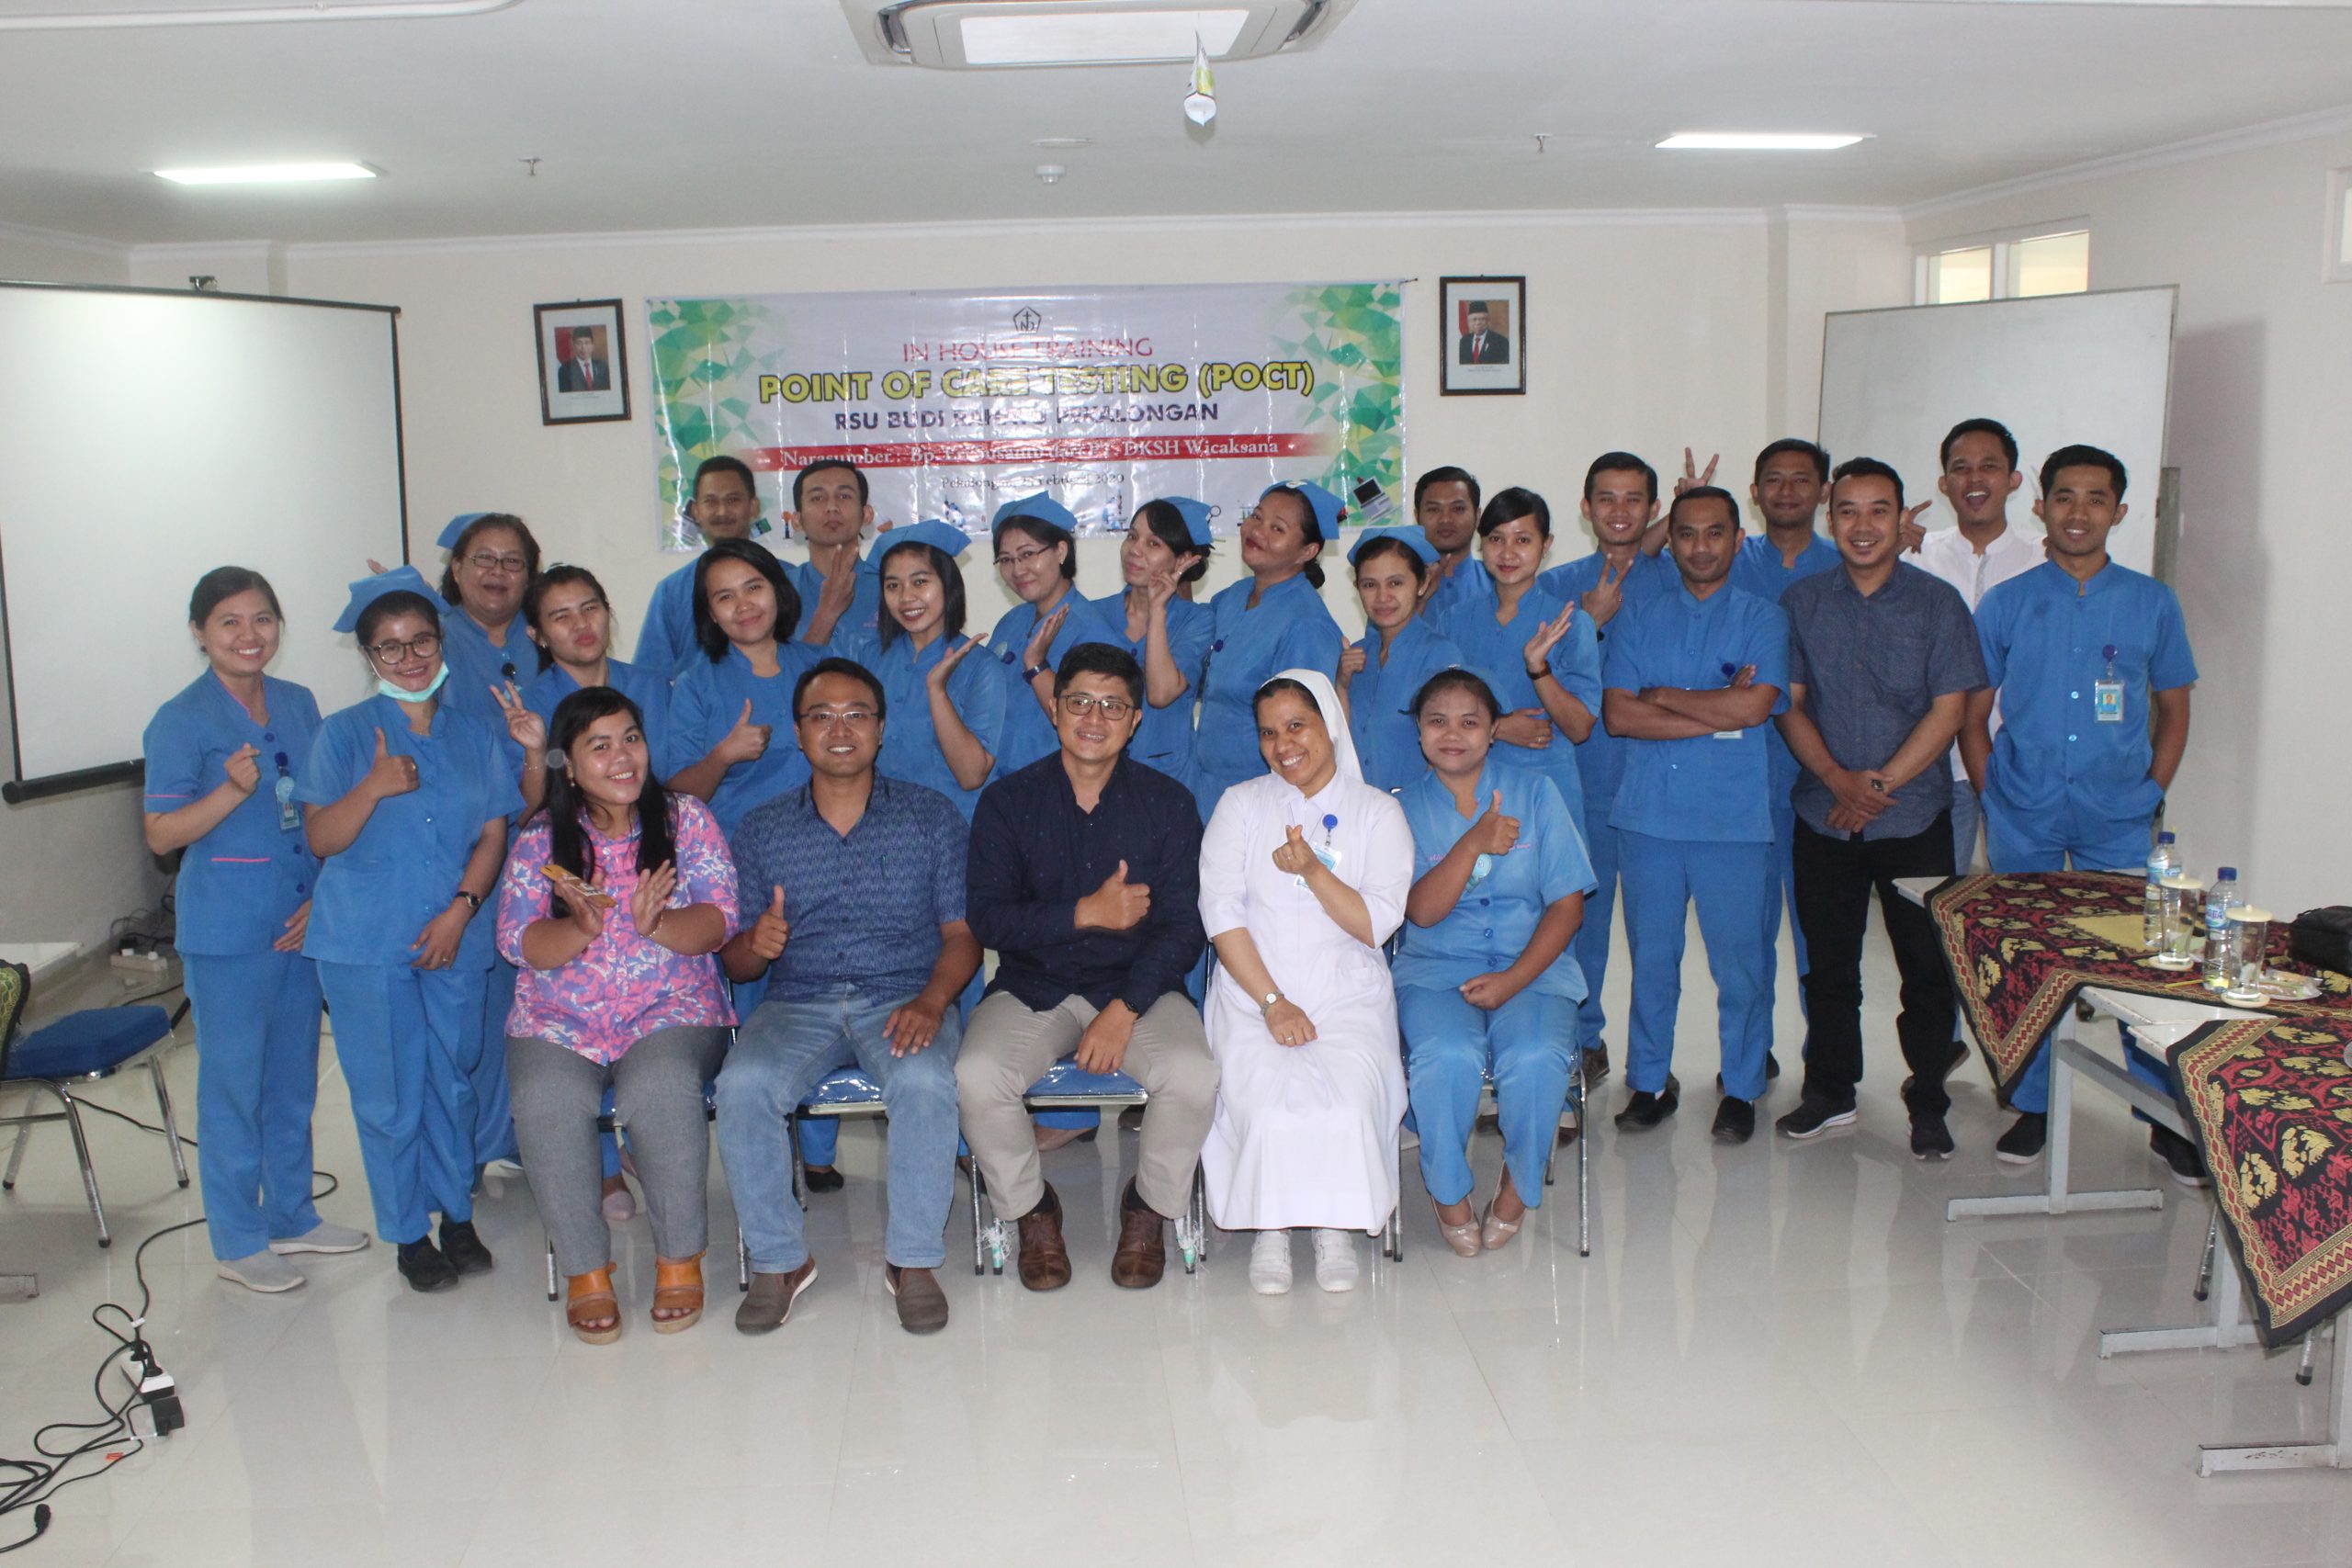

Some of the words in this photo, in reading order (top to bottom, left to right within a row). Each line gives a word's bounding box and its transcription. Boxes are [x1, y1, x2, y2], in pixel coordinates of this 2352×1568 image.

[903, 343, 930, 363] IN
[939, 341, 1023, 361] HOUSE
[1034, 337, 1154, 358] TRAINING
[759, 371, 873, 403] POINT
[882, 370, 933, 400] OF
[940, 367, 1031, 398] CARE
[1037, 363, 1189, 396] TESTING
[1198, 361, 1315, 399] (POCT)
[834, 412, 879, 430] RSU
[888, 410, 945, 429] BUDI
[1056, 402, 1219, 423] PEKALONGAN
[1123, 439, 1181, 457] DKSH
[1182, 437, 1280, 456] Wicaksana
[1094, 472, 1125, 485] 2020
